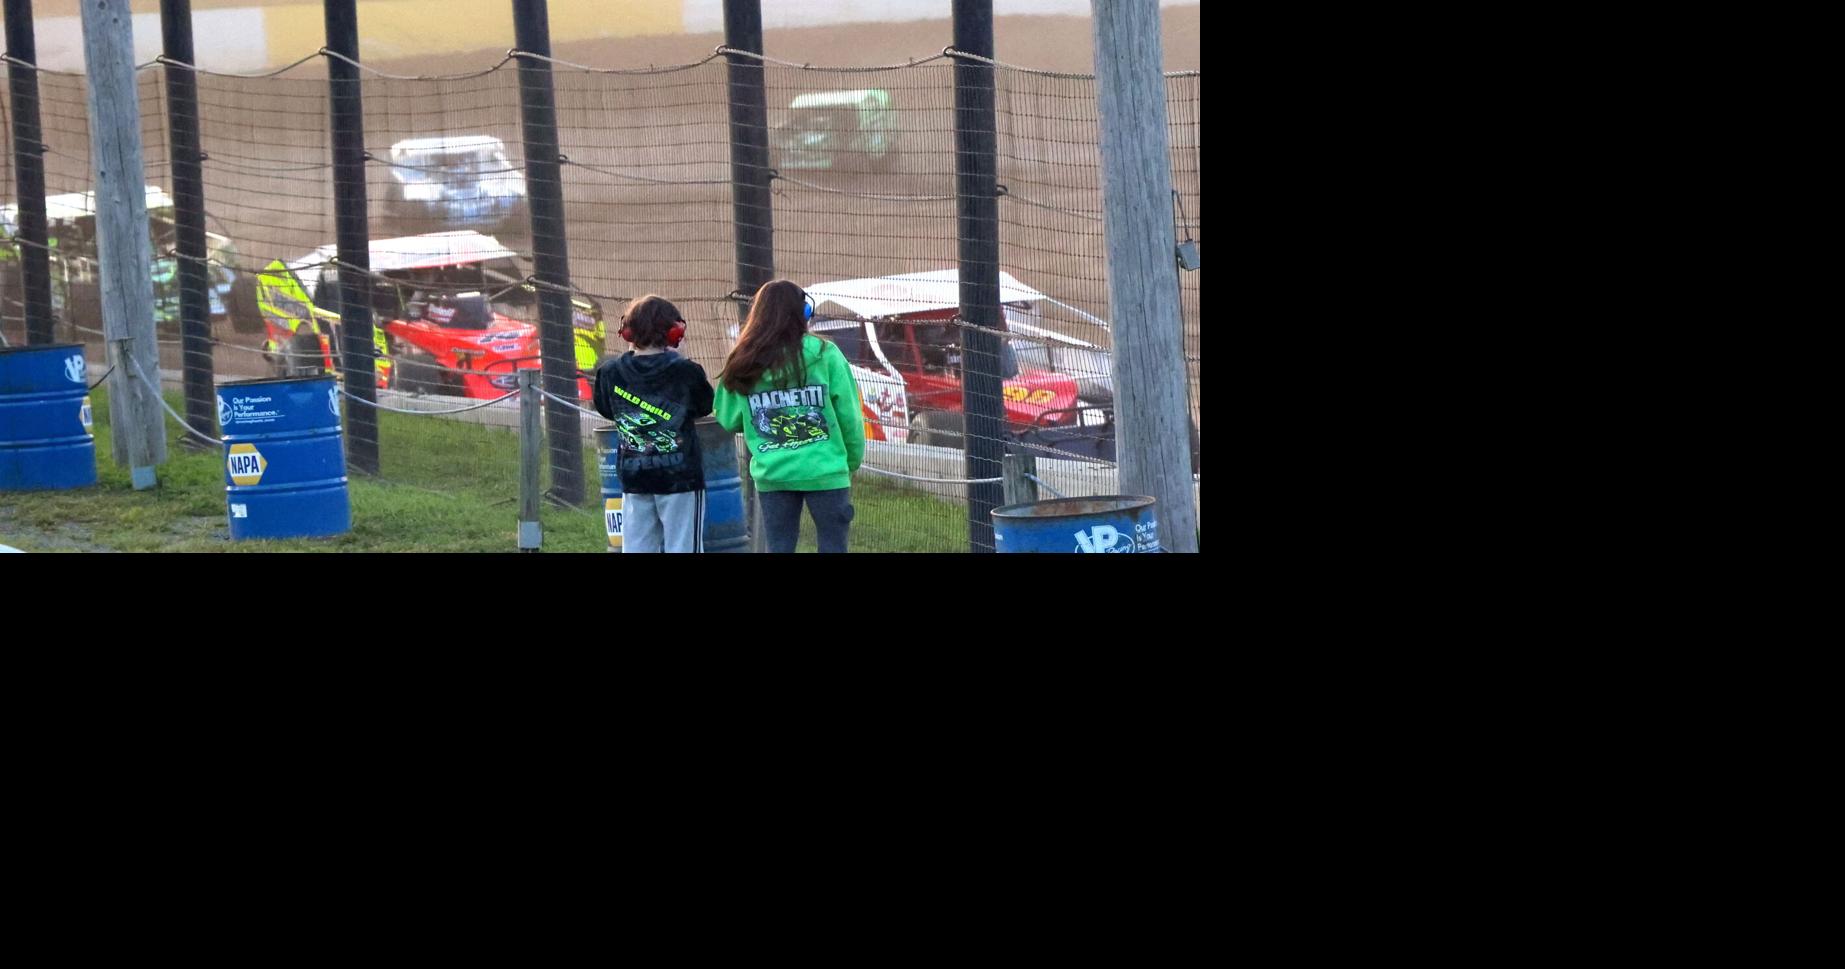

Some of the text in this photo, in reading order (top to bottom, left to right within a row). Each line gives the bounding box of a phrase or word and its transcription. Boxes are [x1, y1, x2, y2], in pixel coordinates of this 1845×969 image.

[614, 385, 641, 405] WILD
[639, 400, 672, 421] CHILD
[748, 385, 825, 417] BACHETTI
[230, 455, 260, 474] NAPA
[606, 512, 623, 533] NAP
[1135, 524, 1147, 532] Our
[1074, 524, 1119, 553] VP
